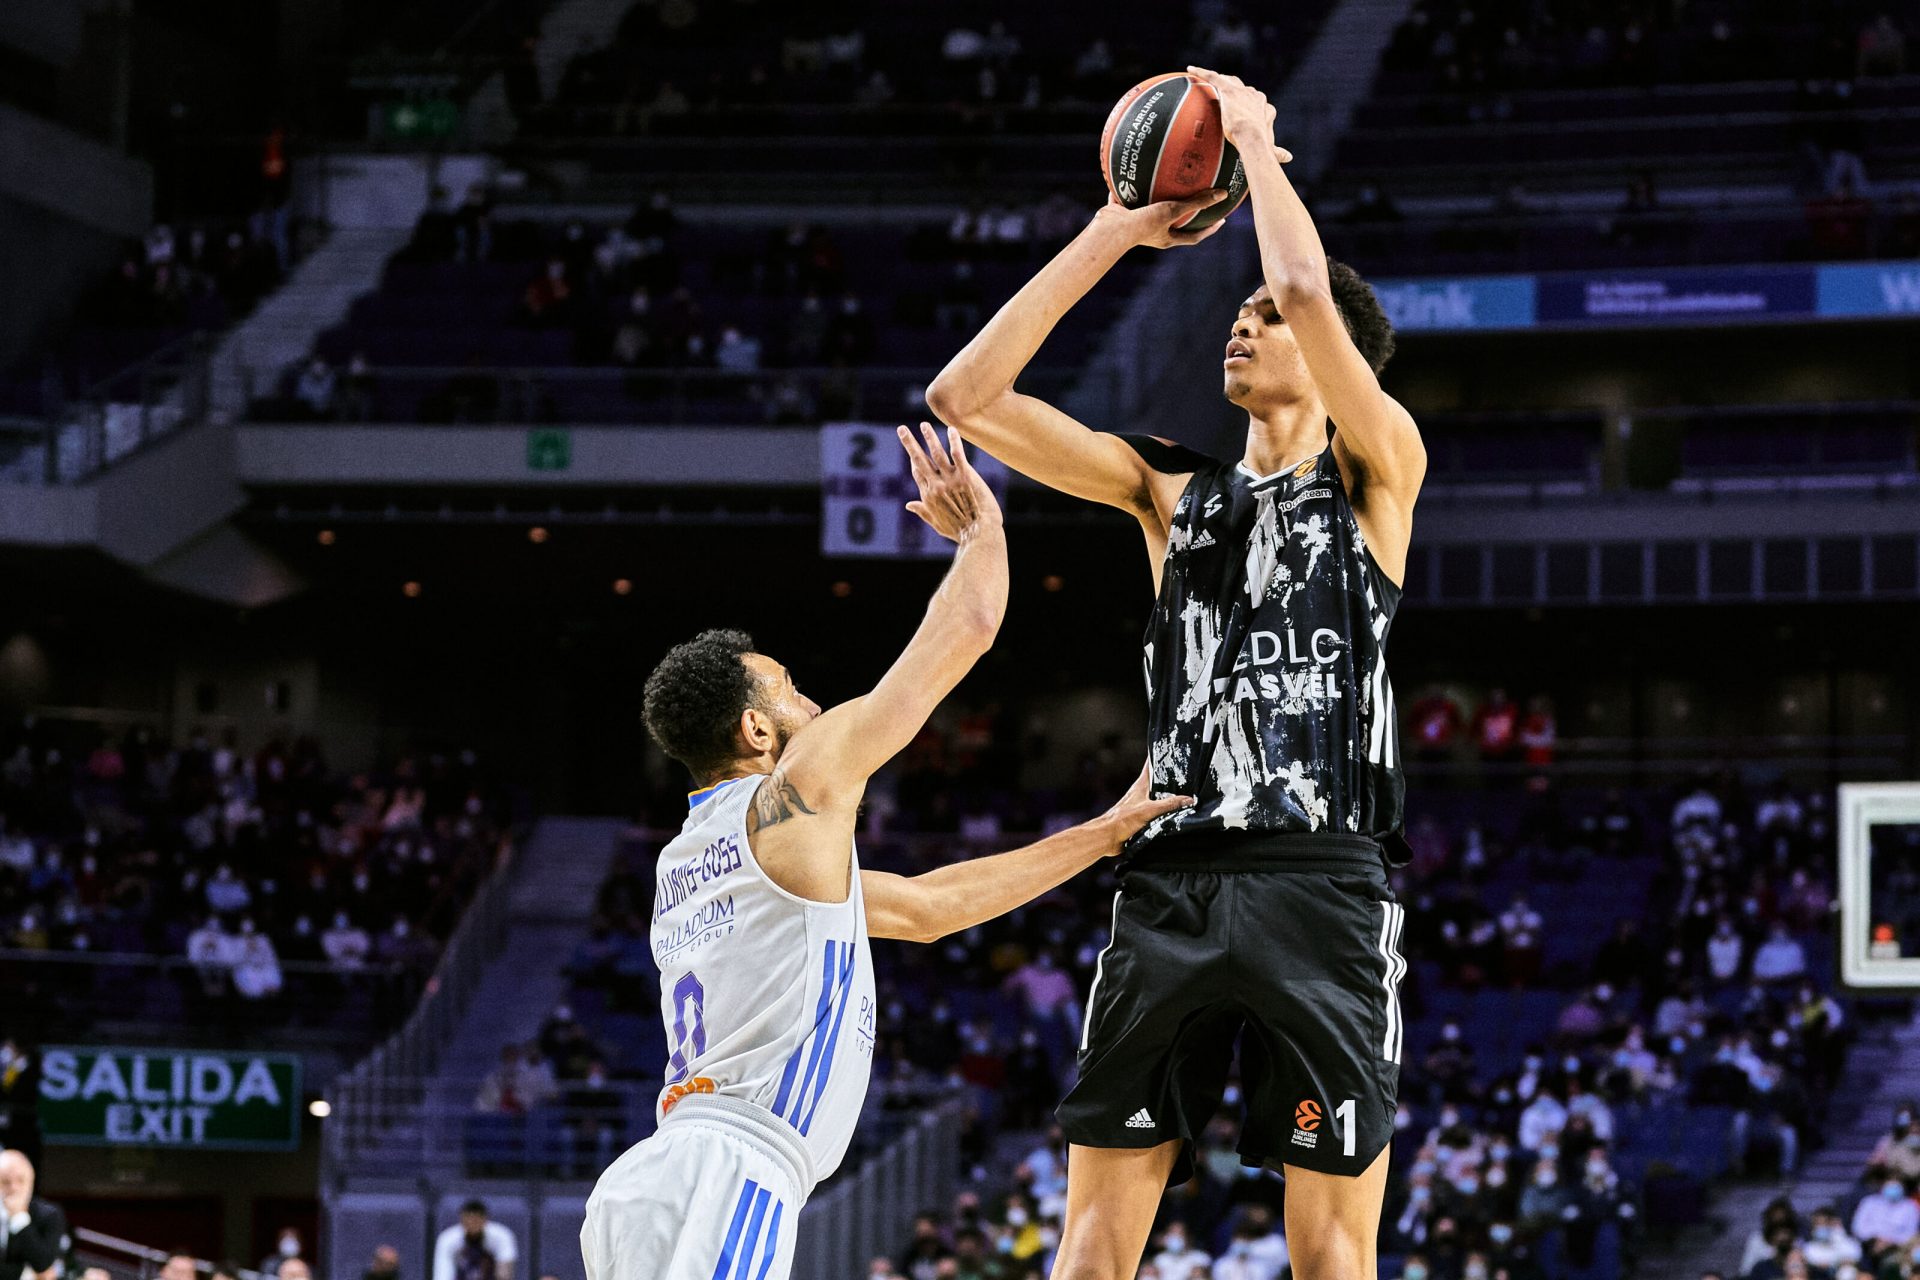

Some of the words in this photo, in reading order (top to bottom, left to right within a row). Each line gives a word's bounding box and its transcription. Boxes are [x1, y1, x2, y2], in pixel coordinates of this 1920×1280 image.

[1119, 130, 1136, 175] TURKISH
[1133, 91, 1164, 130] AIRLINES
[1127, 111, 1158, 181] EuroLeague
[1190, 538, 1216, 550] adidas
[1233, 673, 1342, 704] ASVEL
[653, 837, 742, 925] ILLIAMS-GOSS
[656, 894, 734, 961] PALLADIUM
[39, 1050, 282, 1107] SALIDA
[105, 1103, 214, 1144] EXIT
[1125, 1120, 1156, 1128] adidas
[1293, 1128, 1318, 1139] TURKISH
[1336, 1100, 1356, 1156] 1
